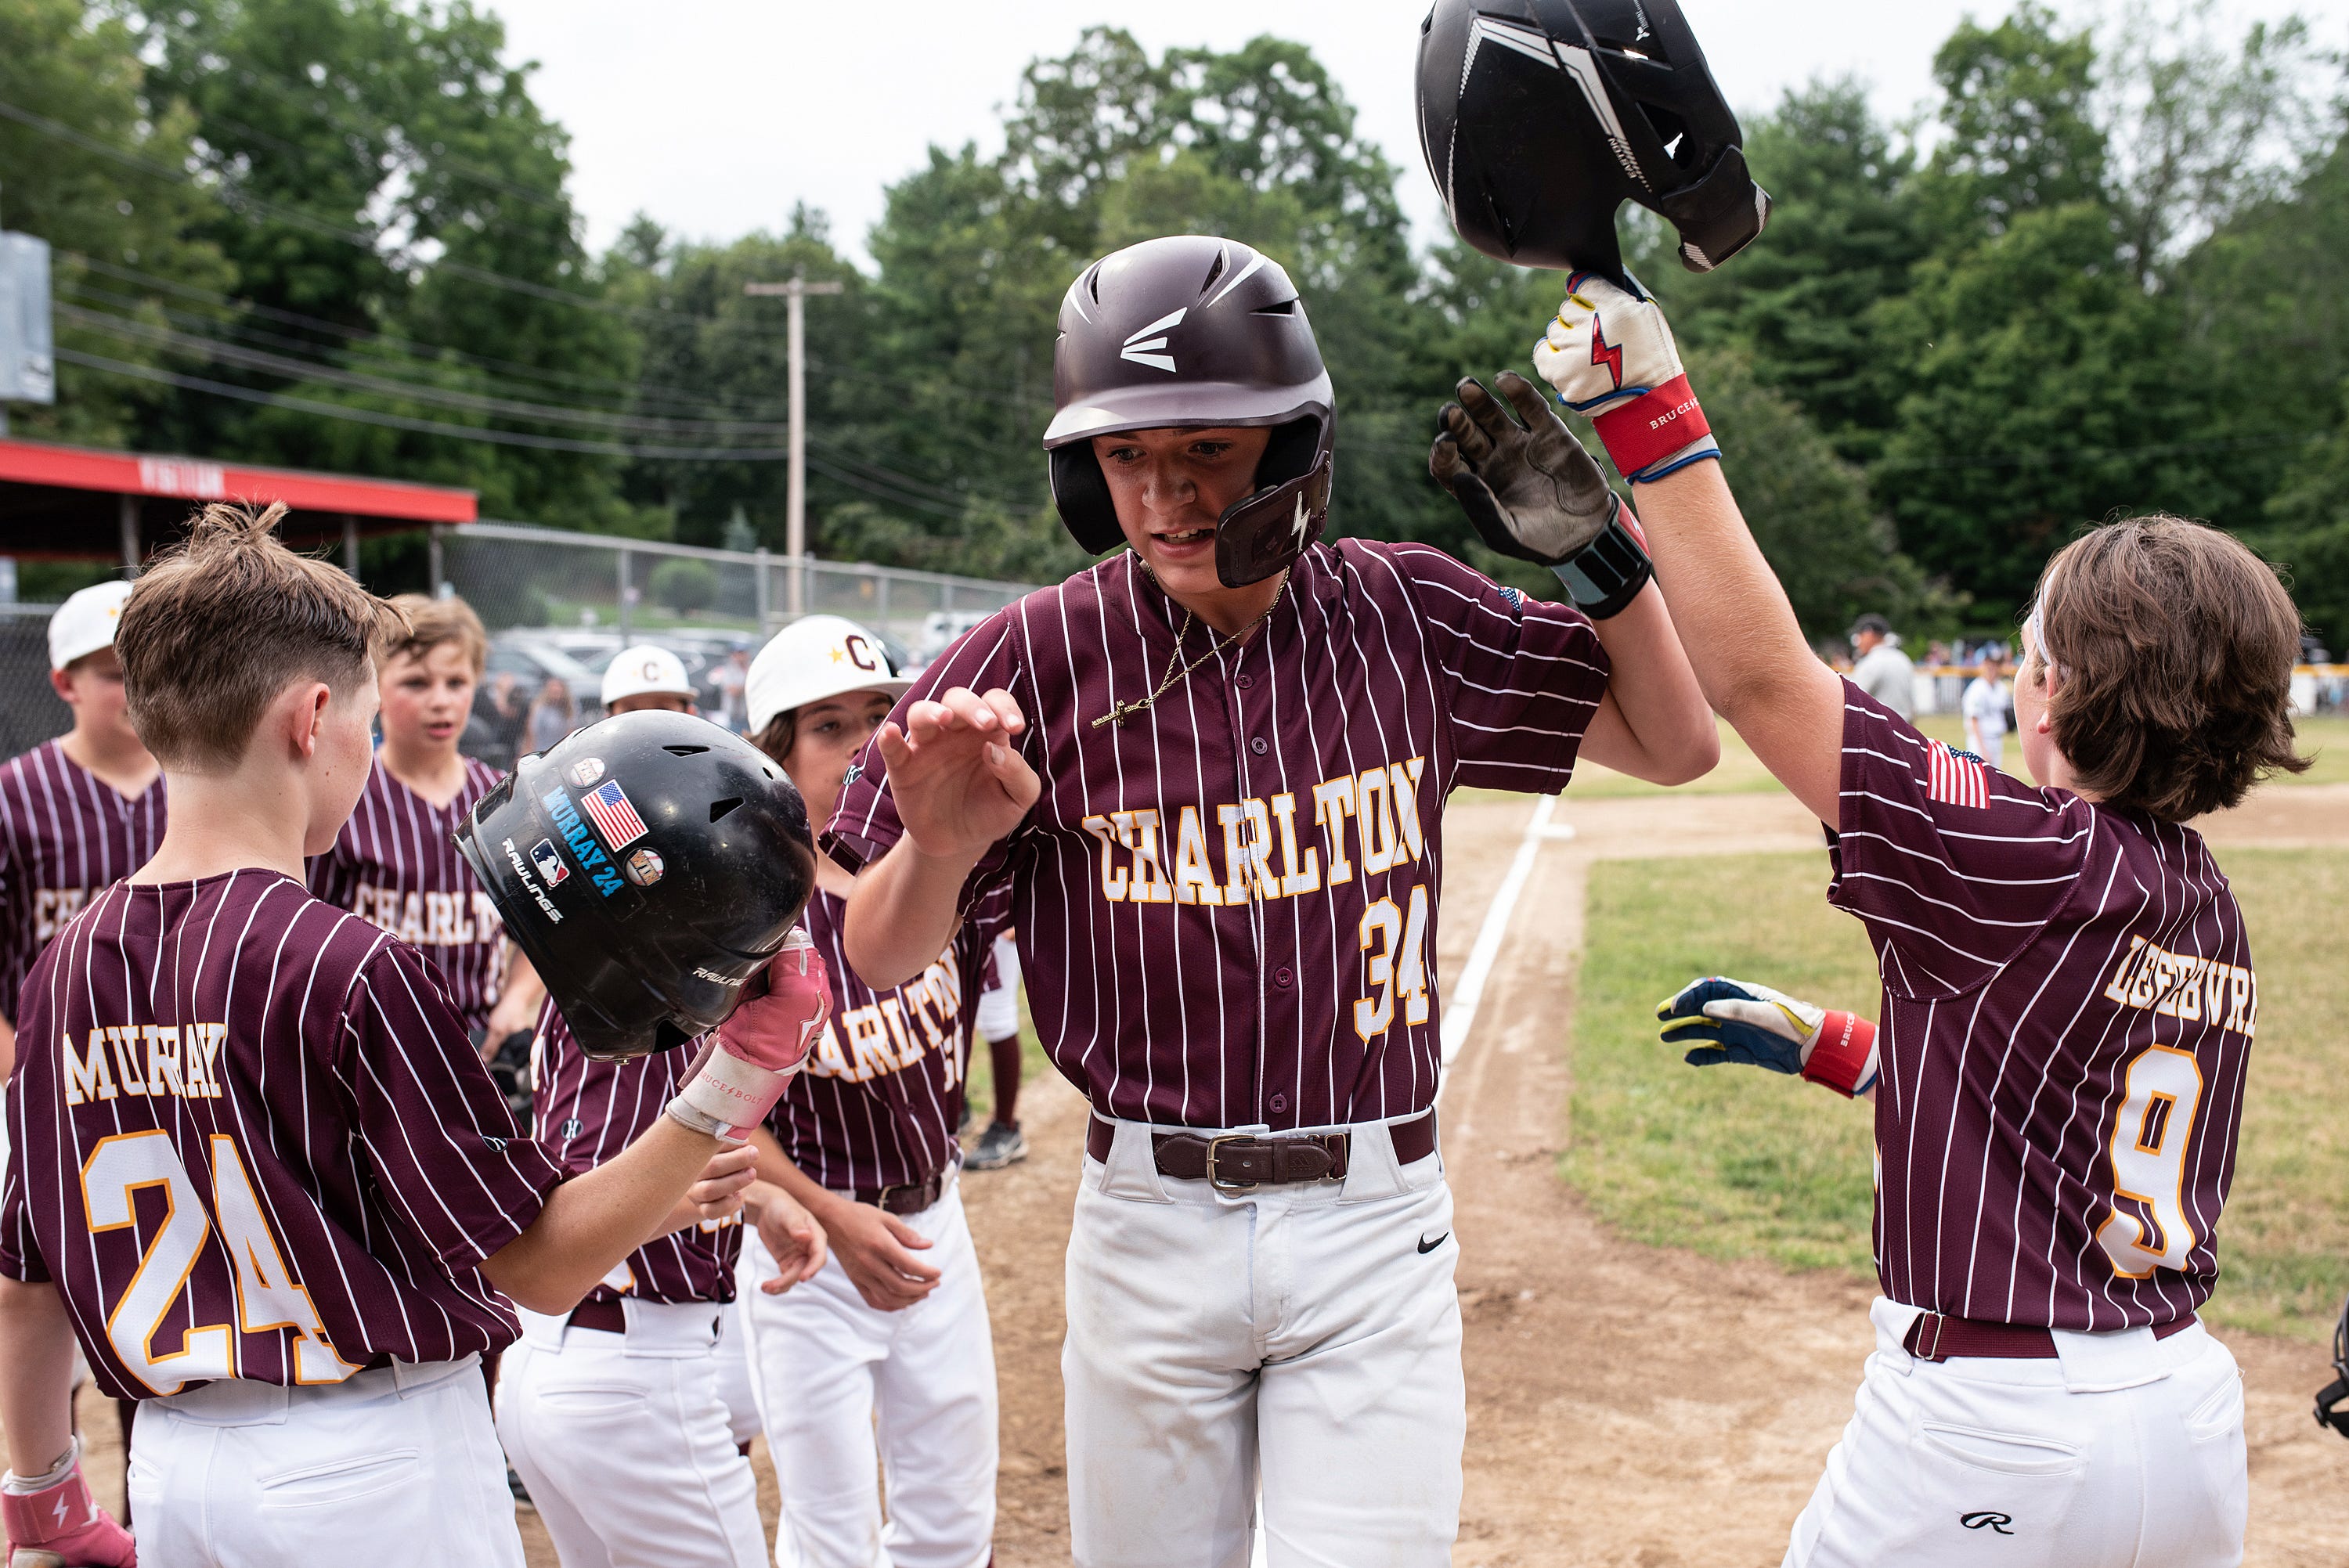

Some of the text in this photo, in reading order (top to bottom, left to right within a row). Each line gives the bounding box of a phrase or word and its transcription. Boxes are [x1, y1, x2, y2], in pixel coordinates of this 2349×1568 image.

[1649, 402, 1691, 430] BRUCE
[642, 661, 659, 683] C
[846, 634, 876, 671] C
[543, 785, 608, 870] MURRAY
[592, 867, 625, 897] 24
[1082, 755, 1425, 907] CHARLTON
[355, 882, 503, 946] CHARLT
[502, 838, 564, 922] RAWLINGS
[1353, 884, 1430, 1044] 34
[800, 946, 962, 1083] ARLTON
[62, 1022, 227, 1105] MURRAY
[734, 1090, 763, 1105] BOLT
[2095, 1044, 2204, 1279] 9
[79, 1129, 366, 1397] 24
